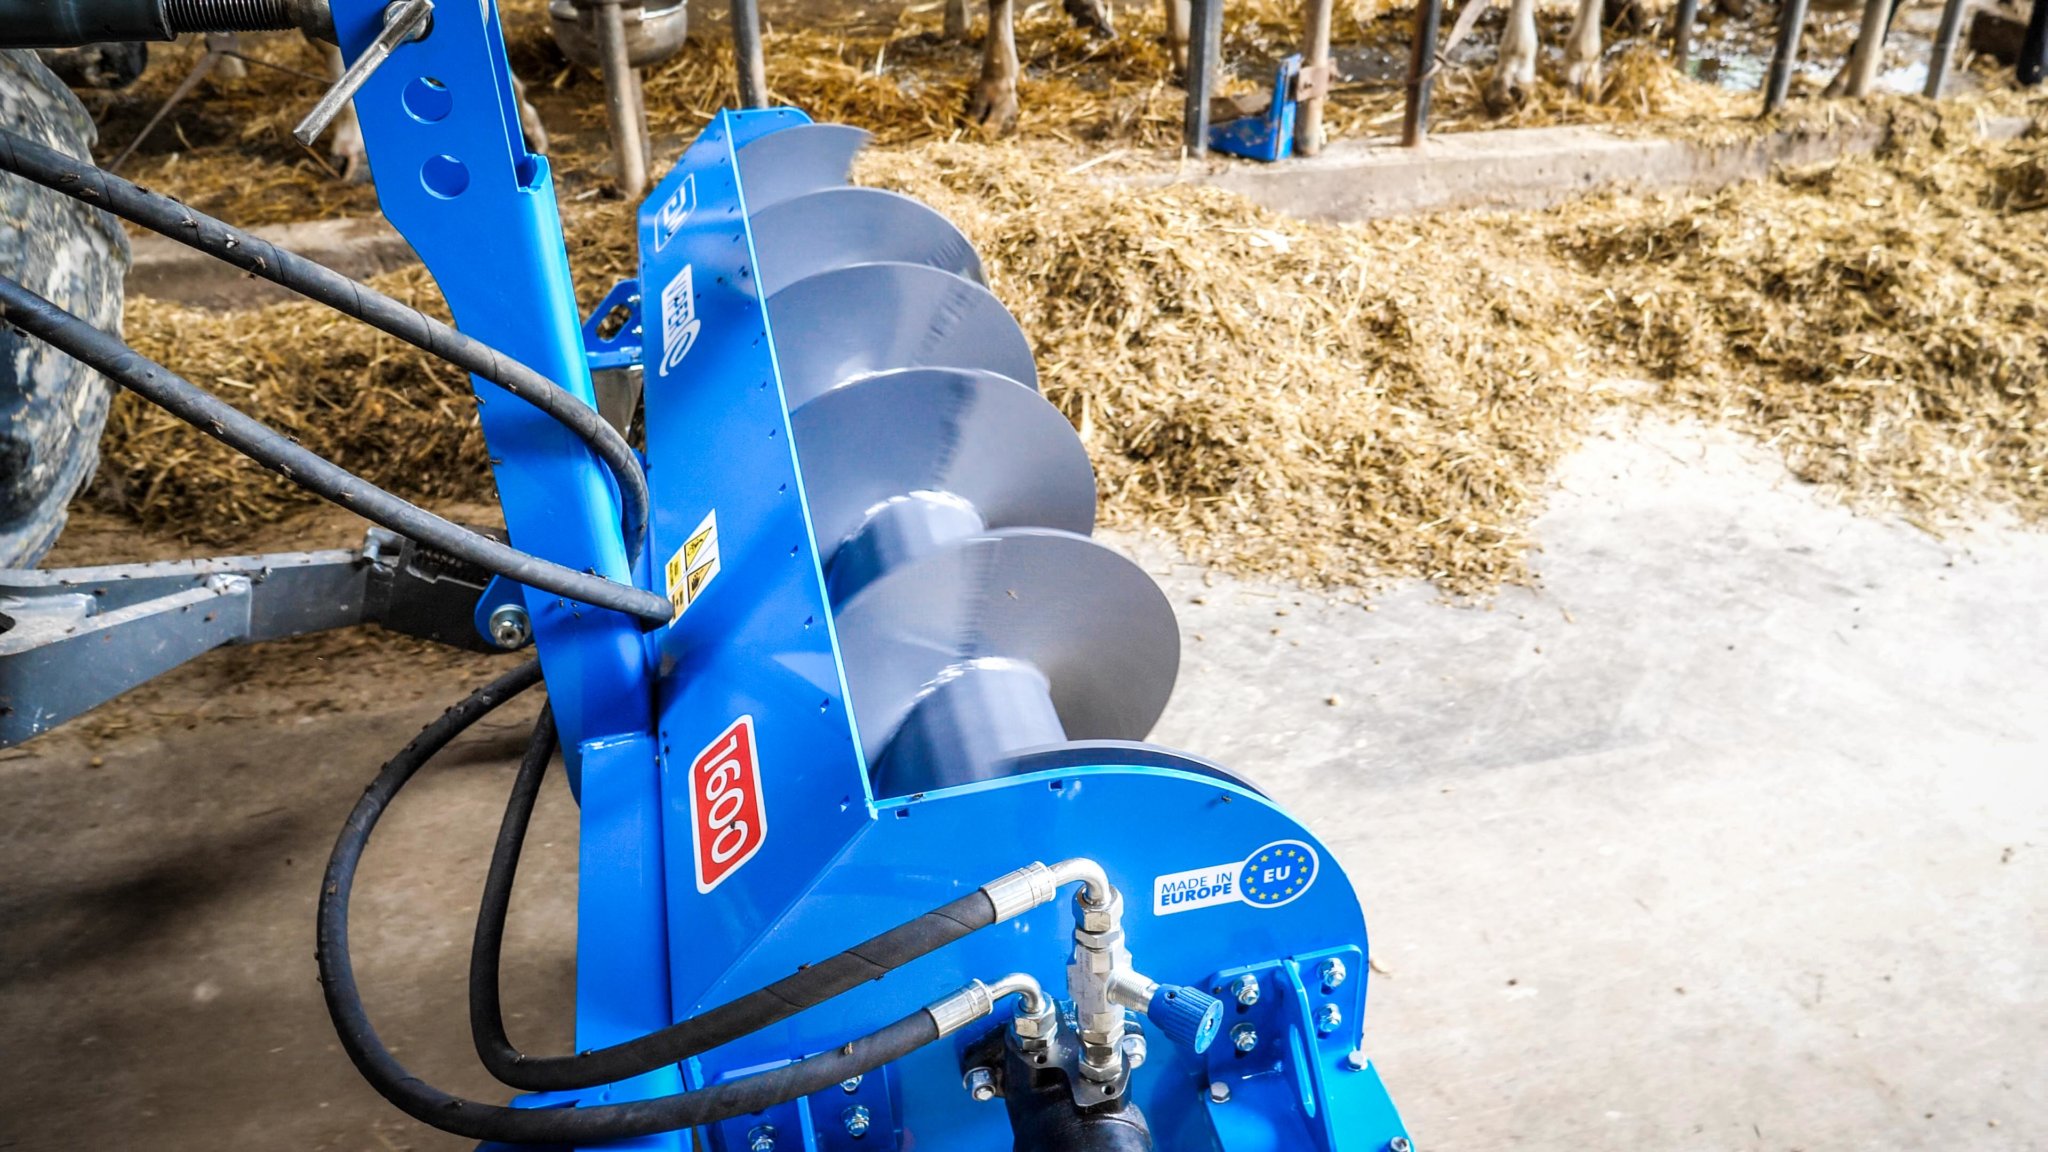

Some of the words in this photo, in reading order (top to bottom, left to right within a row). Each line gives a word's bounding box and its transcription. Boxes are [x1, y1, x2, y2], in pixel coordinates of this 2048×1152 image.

[667, 272, 689, 337] VIPER
[703, 734, 749, 864] 1600
[1161, 876, 1208, 894] MADE
[1216, 871, 1233, 884] IN
[1263, 865, 1291, 884] EU
[1160, 882, 1233, 907] EUROPE
